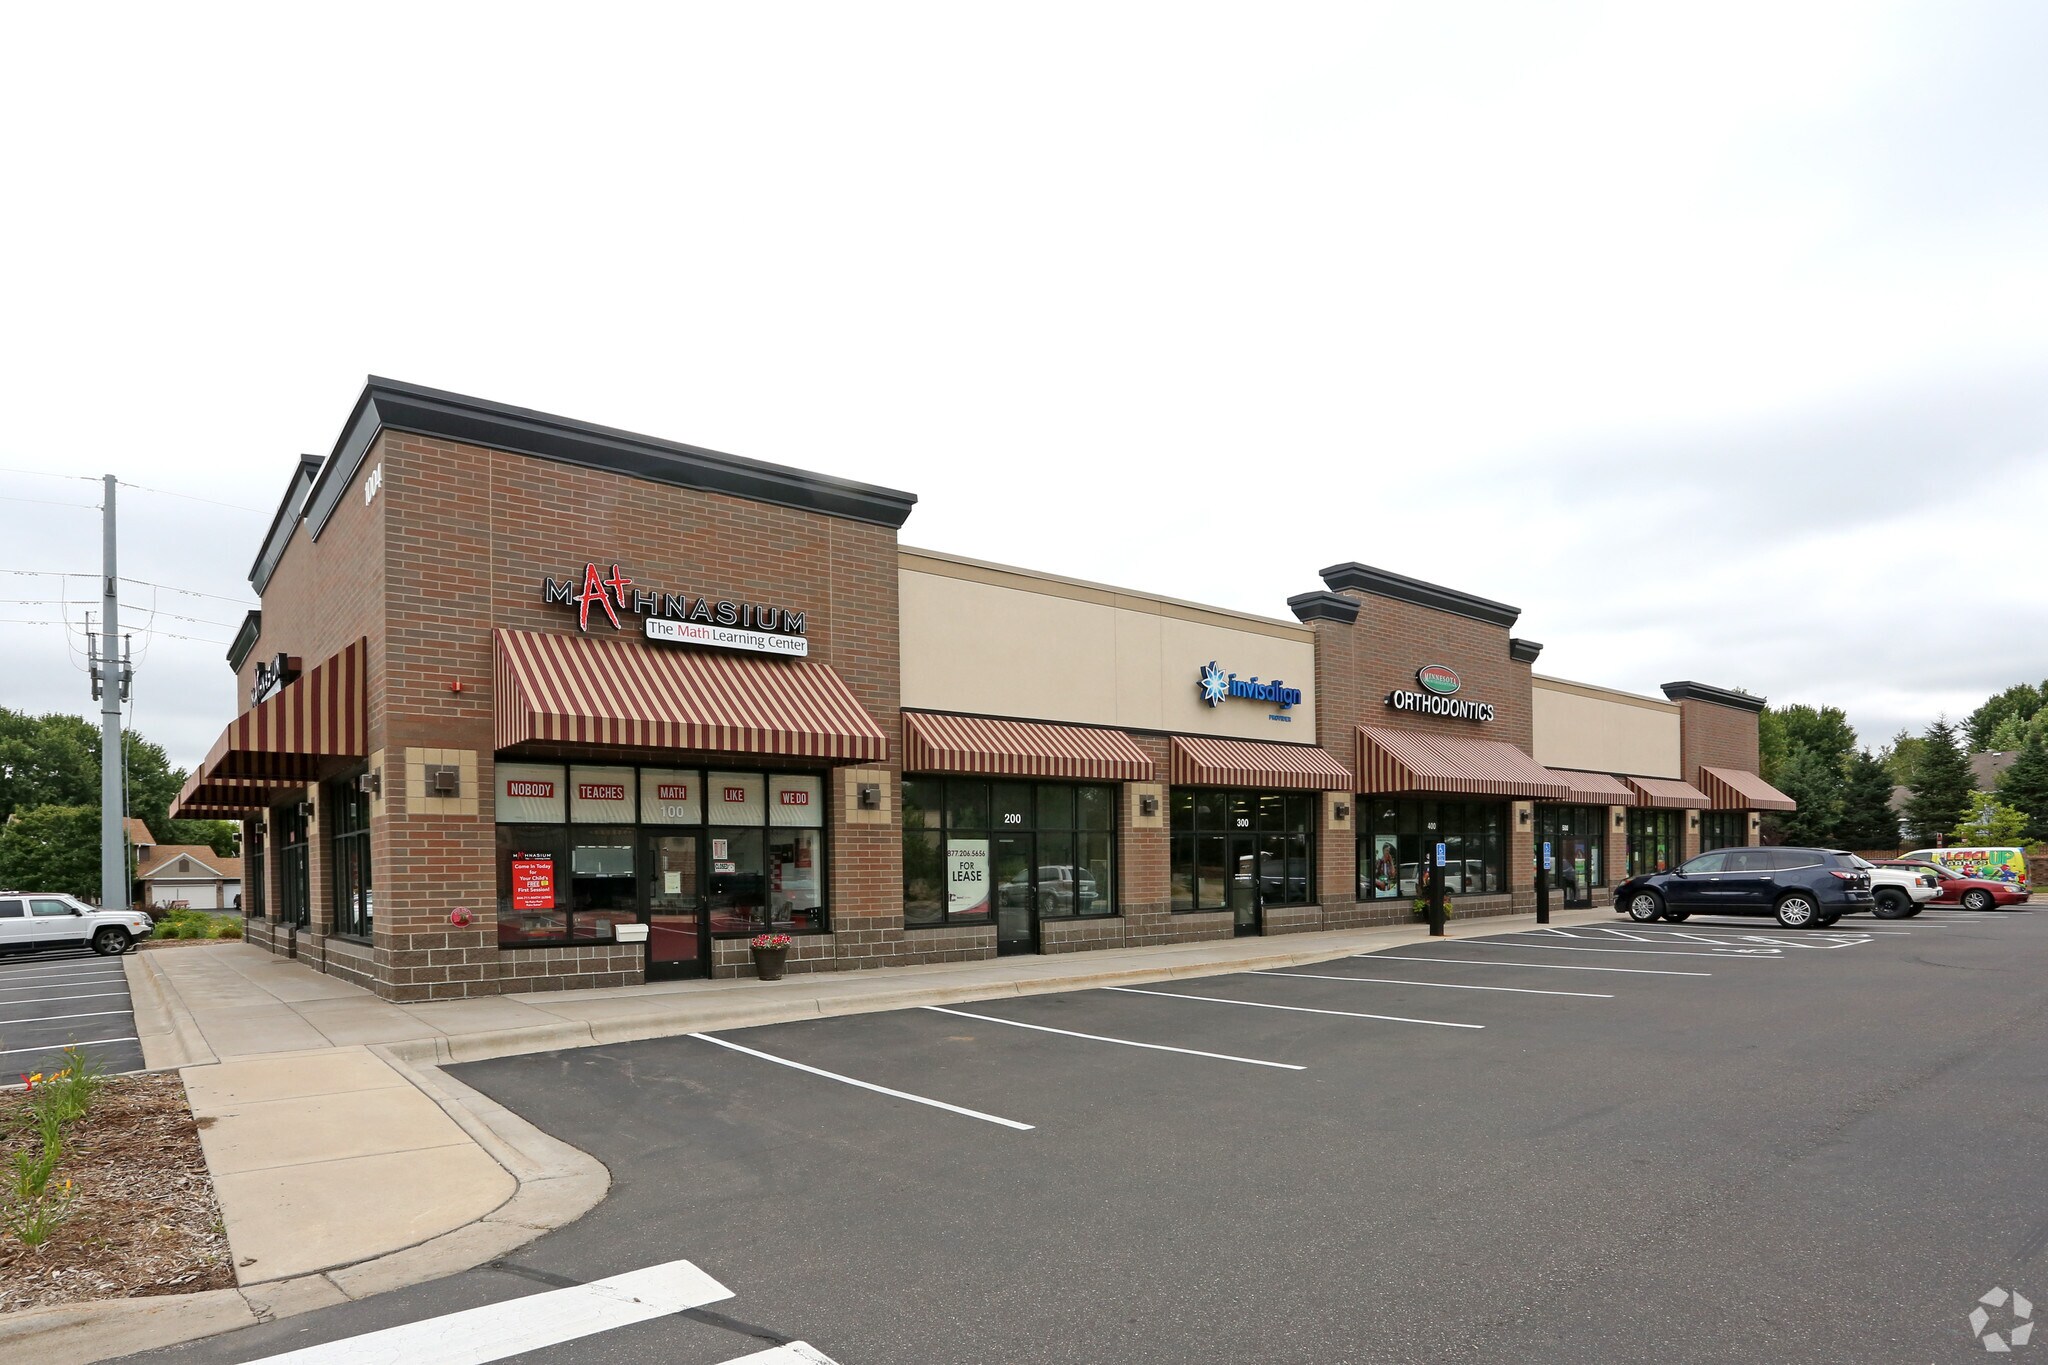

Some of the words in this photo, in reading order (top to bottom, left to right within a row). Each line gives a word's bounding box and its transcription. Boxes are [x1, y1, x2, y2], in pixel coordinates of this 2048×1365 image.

[364, 462, 383, 507] 1004
[648, 621, 674, 635] The
[677, 625, 710, 640] Math
[712, 629, 766, 649] Learning
[768, 636, 806, 651] Center
[1228, 673, 1301, 709] invisalign
[1393, 690, 1494, 721] ORTHODONTICS
[511, 782, 552, 797] NOBODY
[580, 786, 623, 799] TEACHES
[660, 787, 685, 799] MATH
[725, 789, 744, 801] LIKE
[782, 792, 795, 804] WE
[796, 793, 807, 804] DO
[661, 806, 684, 818] 100
[1004, 813, 1022, 824] 200
[1236, 818, 1249, 828] 300
[1427, 822, 1437, 830] 400
[1946, 851, 1988, 861] LEVEL
[1988, 850, 2015, 865] UP
[959, 861, 975, 870] FOR
[952, 870, 982, 882] LEASE
